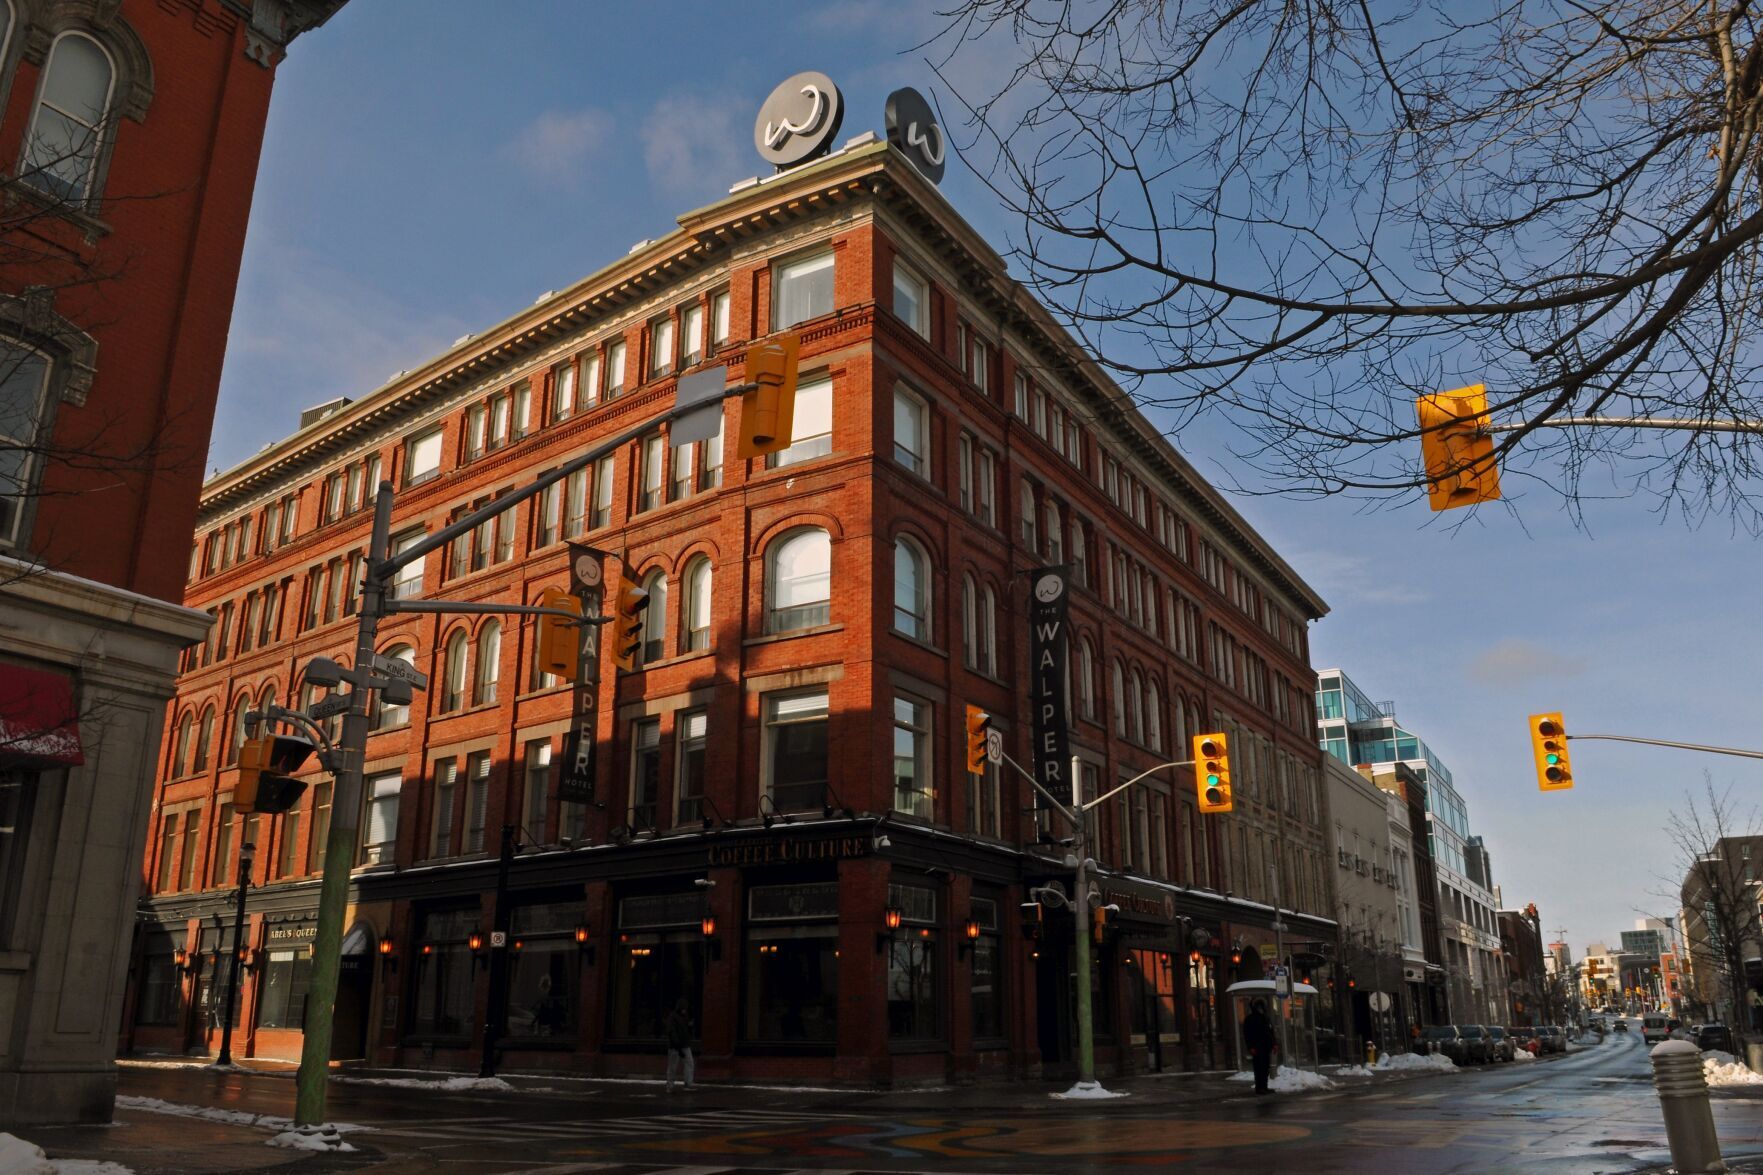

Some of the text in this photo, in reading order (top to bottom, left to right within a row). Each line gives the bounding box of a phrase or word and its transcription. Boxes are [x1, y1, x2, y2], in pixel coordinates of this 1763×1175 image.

[1039, 607, 1058, 615] THE
[386, 662, 406, 678] KING
[1036, 621, 1061, 782] WALPER
[563, 777, 593, 790] HOTEL
[779, 837, 864, 860] CULTURE
